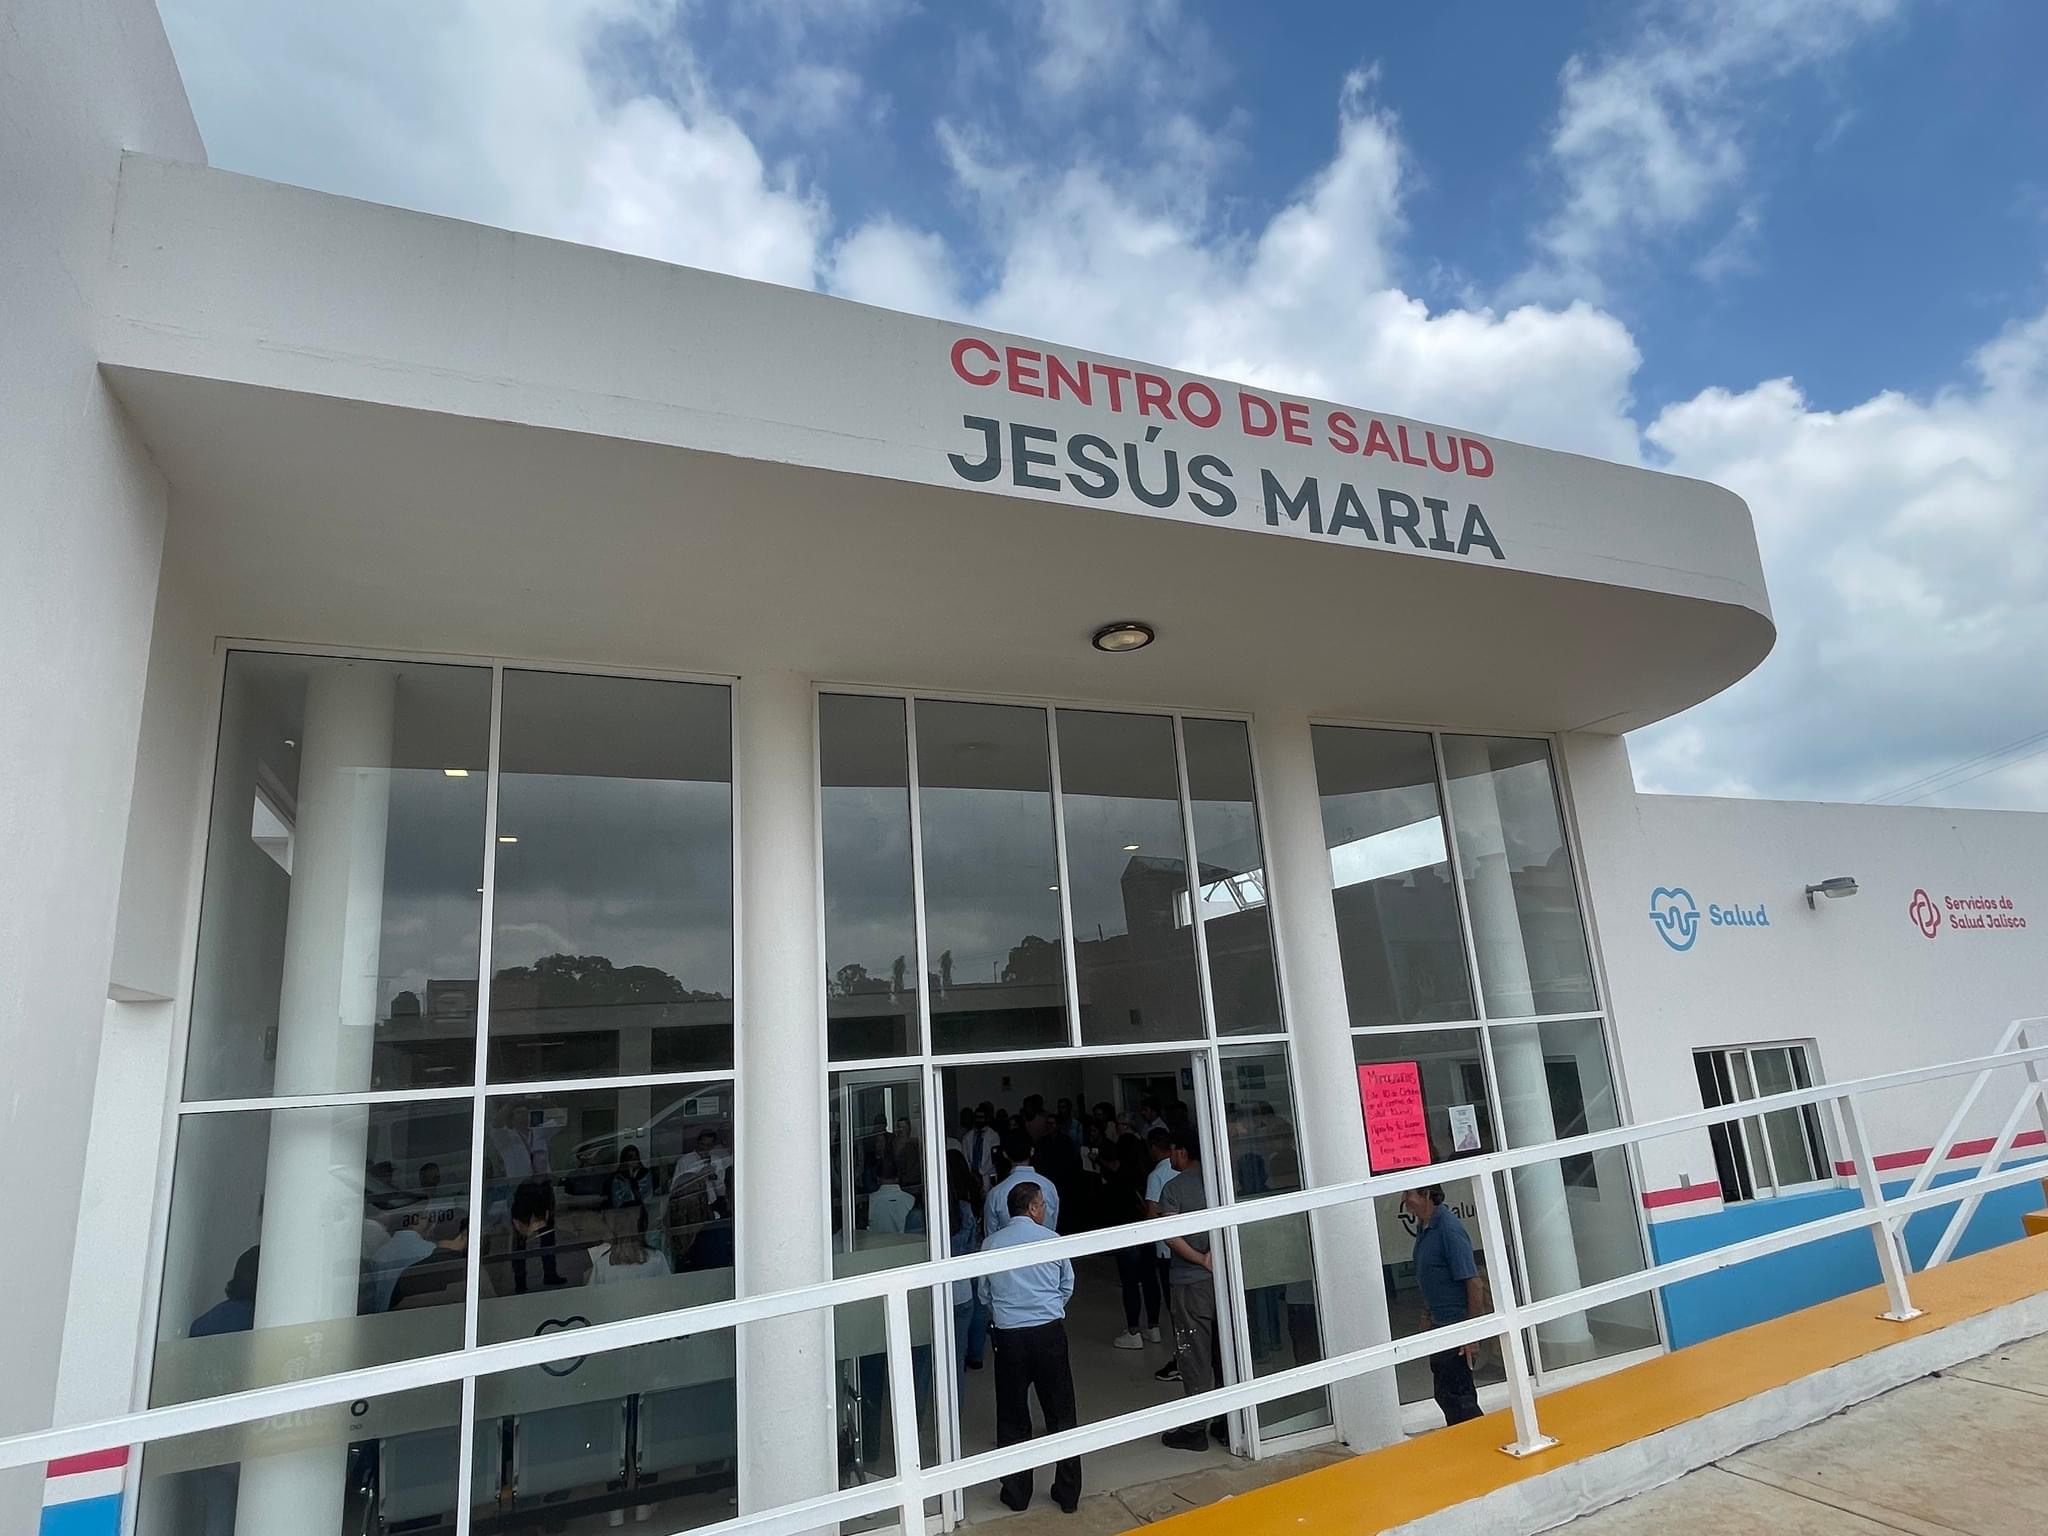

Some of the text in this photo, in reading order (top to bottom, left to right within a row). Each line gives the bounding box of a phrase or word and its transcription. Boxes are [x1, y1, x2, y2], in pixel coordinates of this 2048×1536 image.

[950, 338, 1495, 478] CENTRO DE SALUD
[946, 414, 1506, 560] JESÚS MARIA
[1944, 895, 2013, 910] Servicios de
[1710, 904, 1770, 927] Salud
[1949, 914, 2026, 929] Salud Jalisco
[1444, 1202, 1478, 1219] alu
